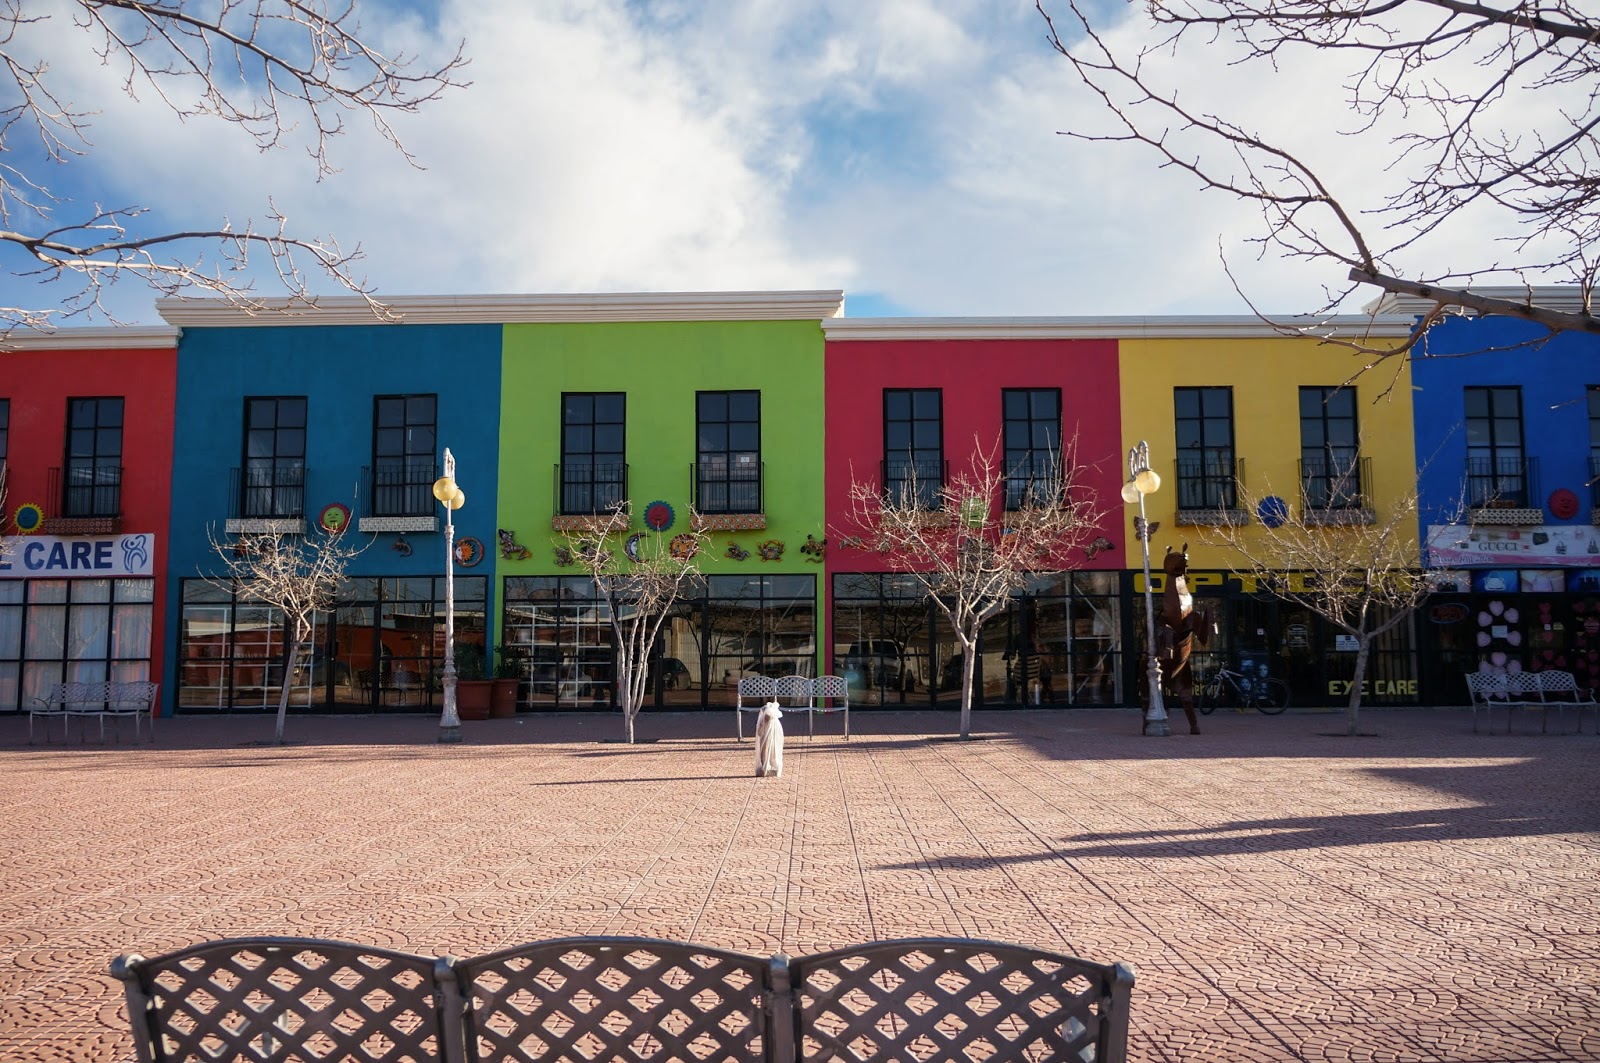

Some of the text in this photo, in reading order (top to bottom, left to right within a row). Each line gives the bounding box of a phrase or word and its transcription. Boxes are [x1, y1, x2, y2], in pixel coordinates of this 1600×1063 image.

[1478, 542, 1518, 551] GUCCI
[23, 541, 113, 570] CARE
[1328, 679, 1419, 696] EYE CARE
